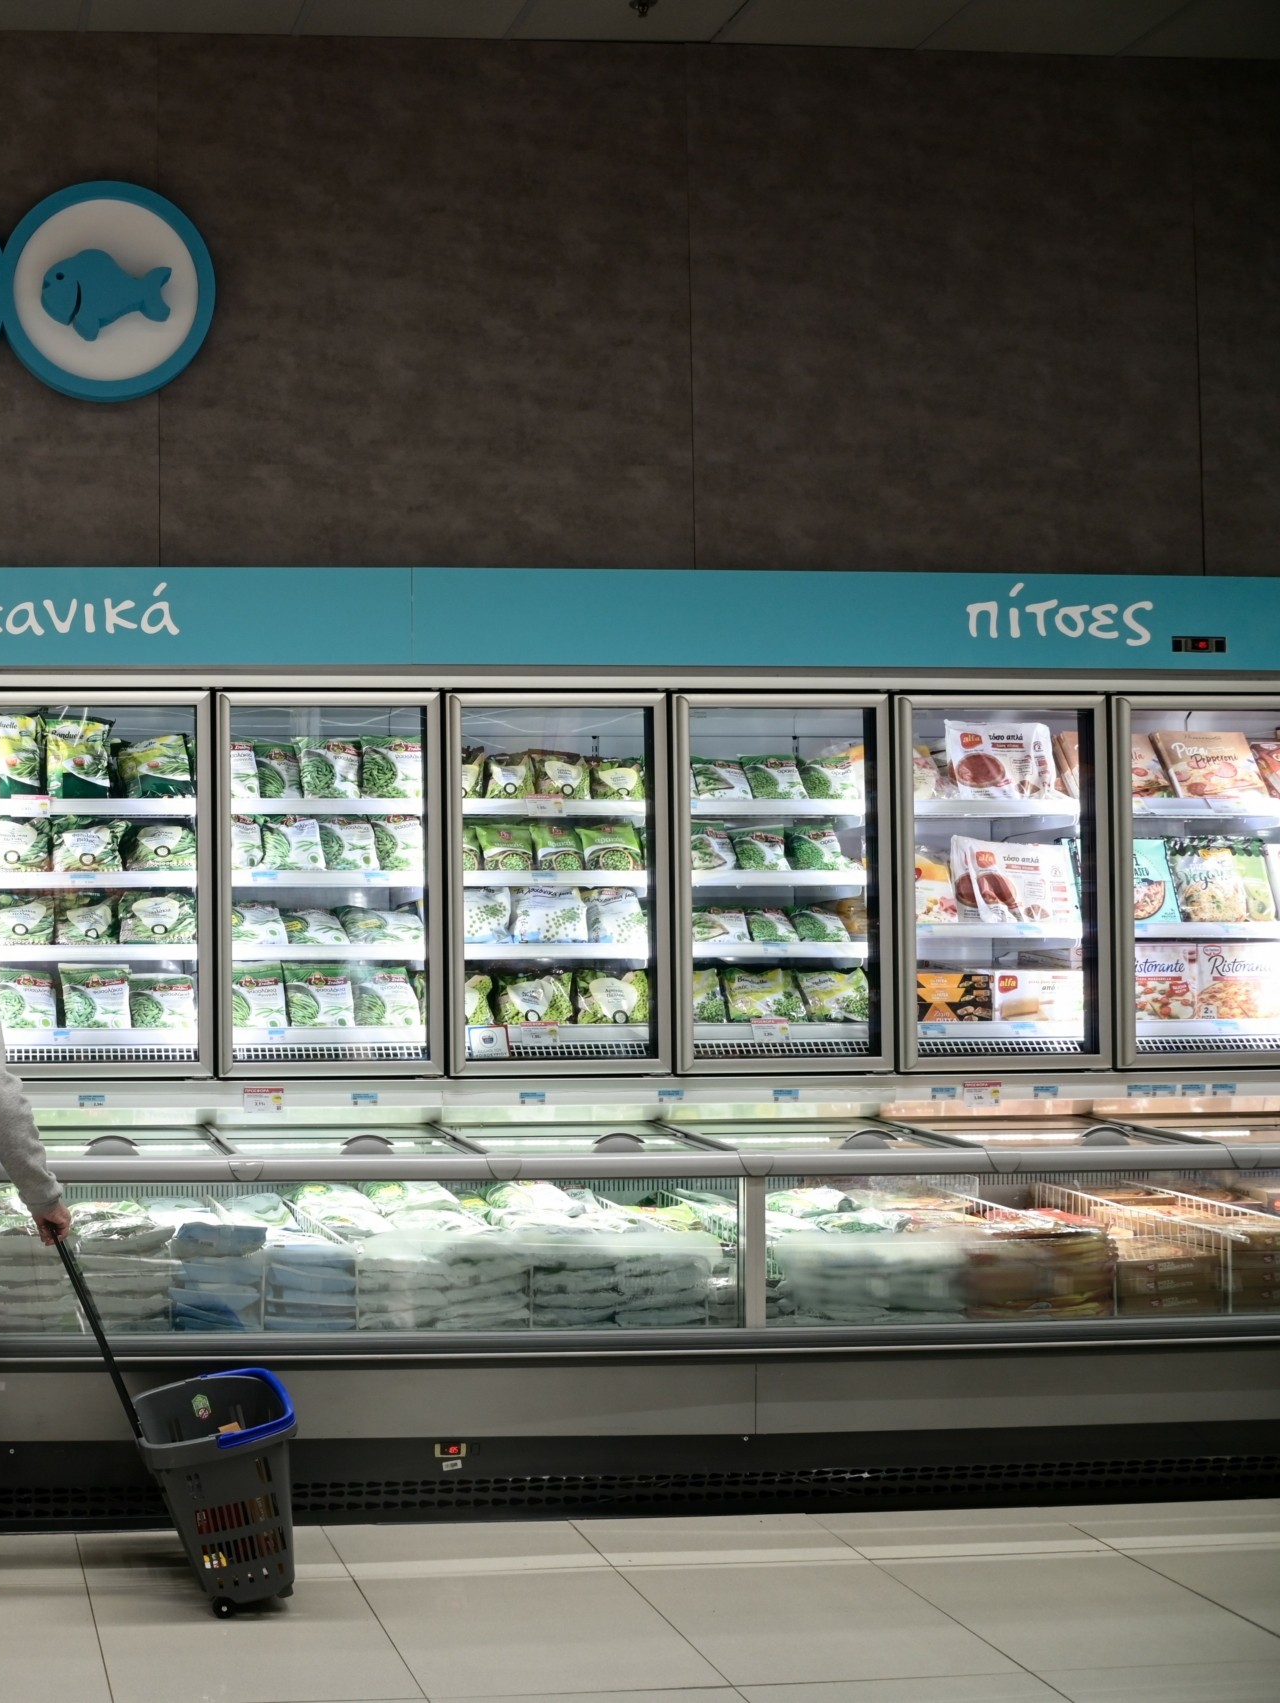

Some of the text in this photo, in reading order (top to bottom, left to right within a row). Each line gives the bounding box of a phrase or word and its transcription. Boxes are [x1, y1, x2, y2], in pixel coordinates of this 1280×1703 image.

[966, 582, 1153, 646] πίτσες
[988, 733, 1024, 741] τόσο απλά
[1172, 743, 1208, 758] Pizza
[1191, 753, 1238, 767] Pepperoni
[1021, 854, 1040, 863] απλά
[1000, 979, 1017, 987] alfa
